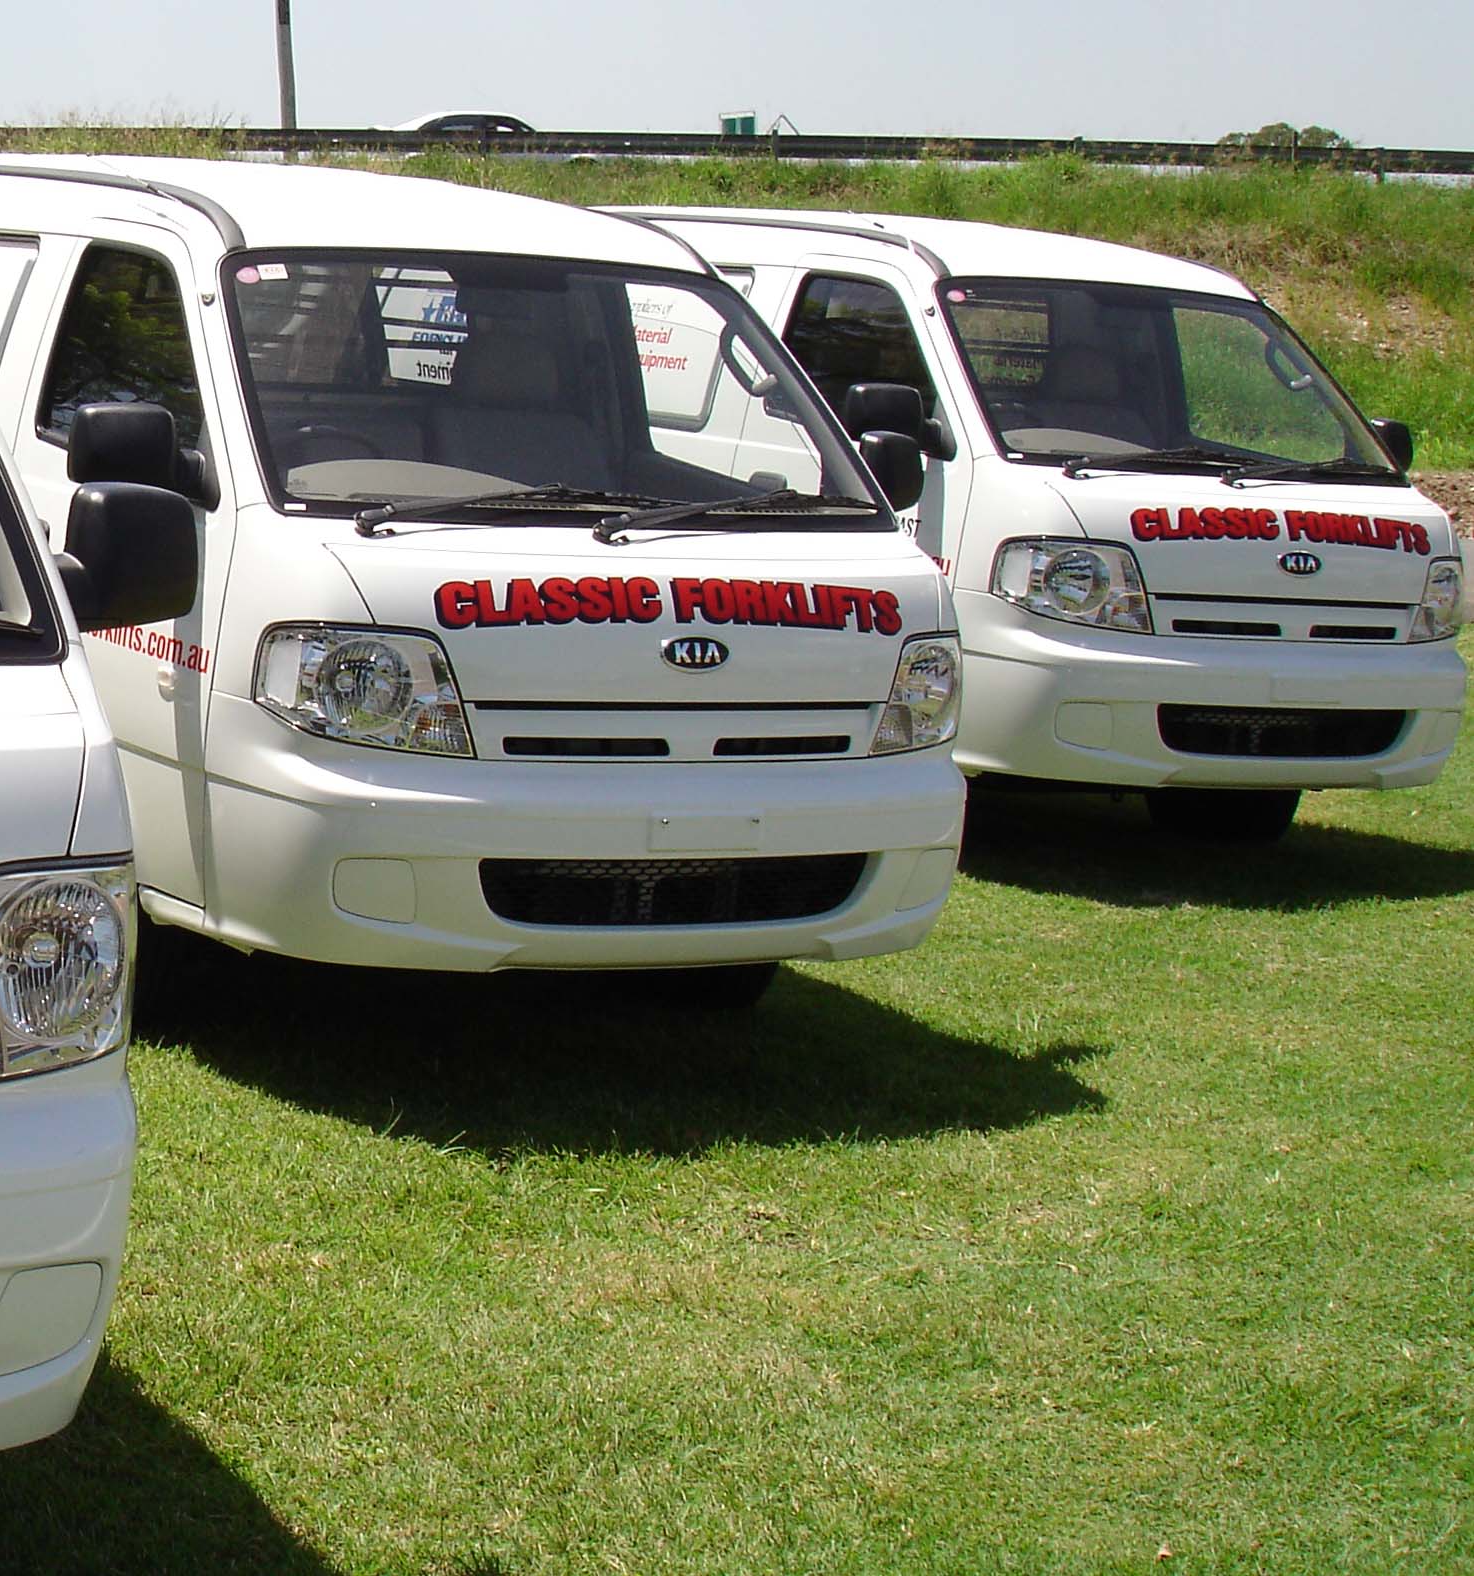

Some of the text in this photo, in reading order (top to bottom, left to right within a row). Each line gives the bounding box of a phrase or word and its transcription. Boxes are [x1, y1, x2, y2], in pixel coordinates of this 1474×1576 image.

[634, 325, 673, 344] aterial
[639, 350, 687, 372] uipment
[1130, 507, 1431, 555] CLASSIC FORKLIFTS
[1286, 555, 1317, 571] KIA
[434, 576, 903, 636] CLASSIC FORKLIFTS
[673, 641, 722, 663] KIA
